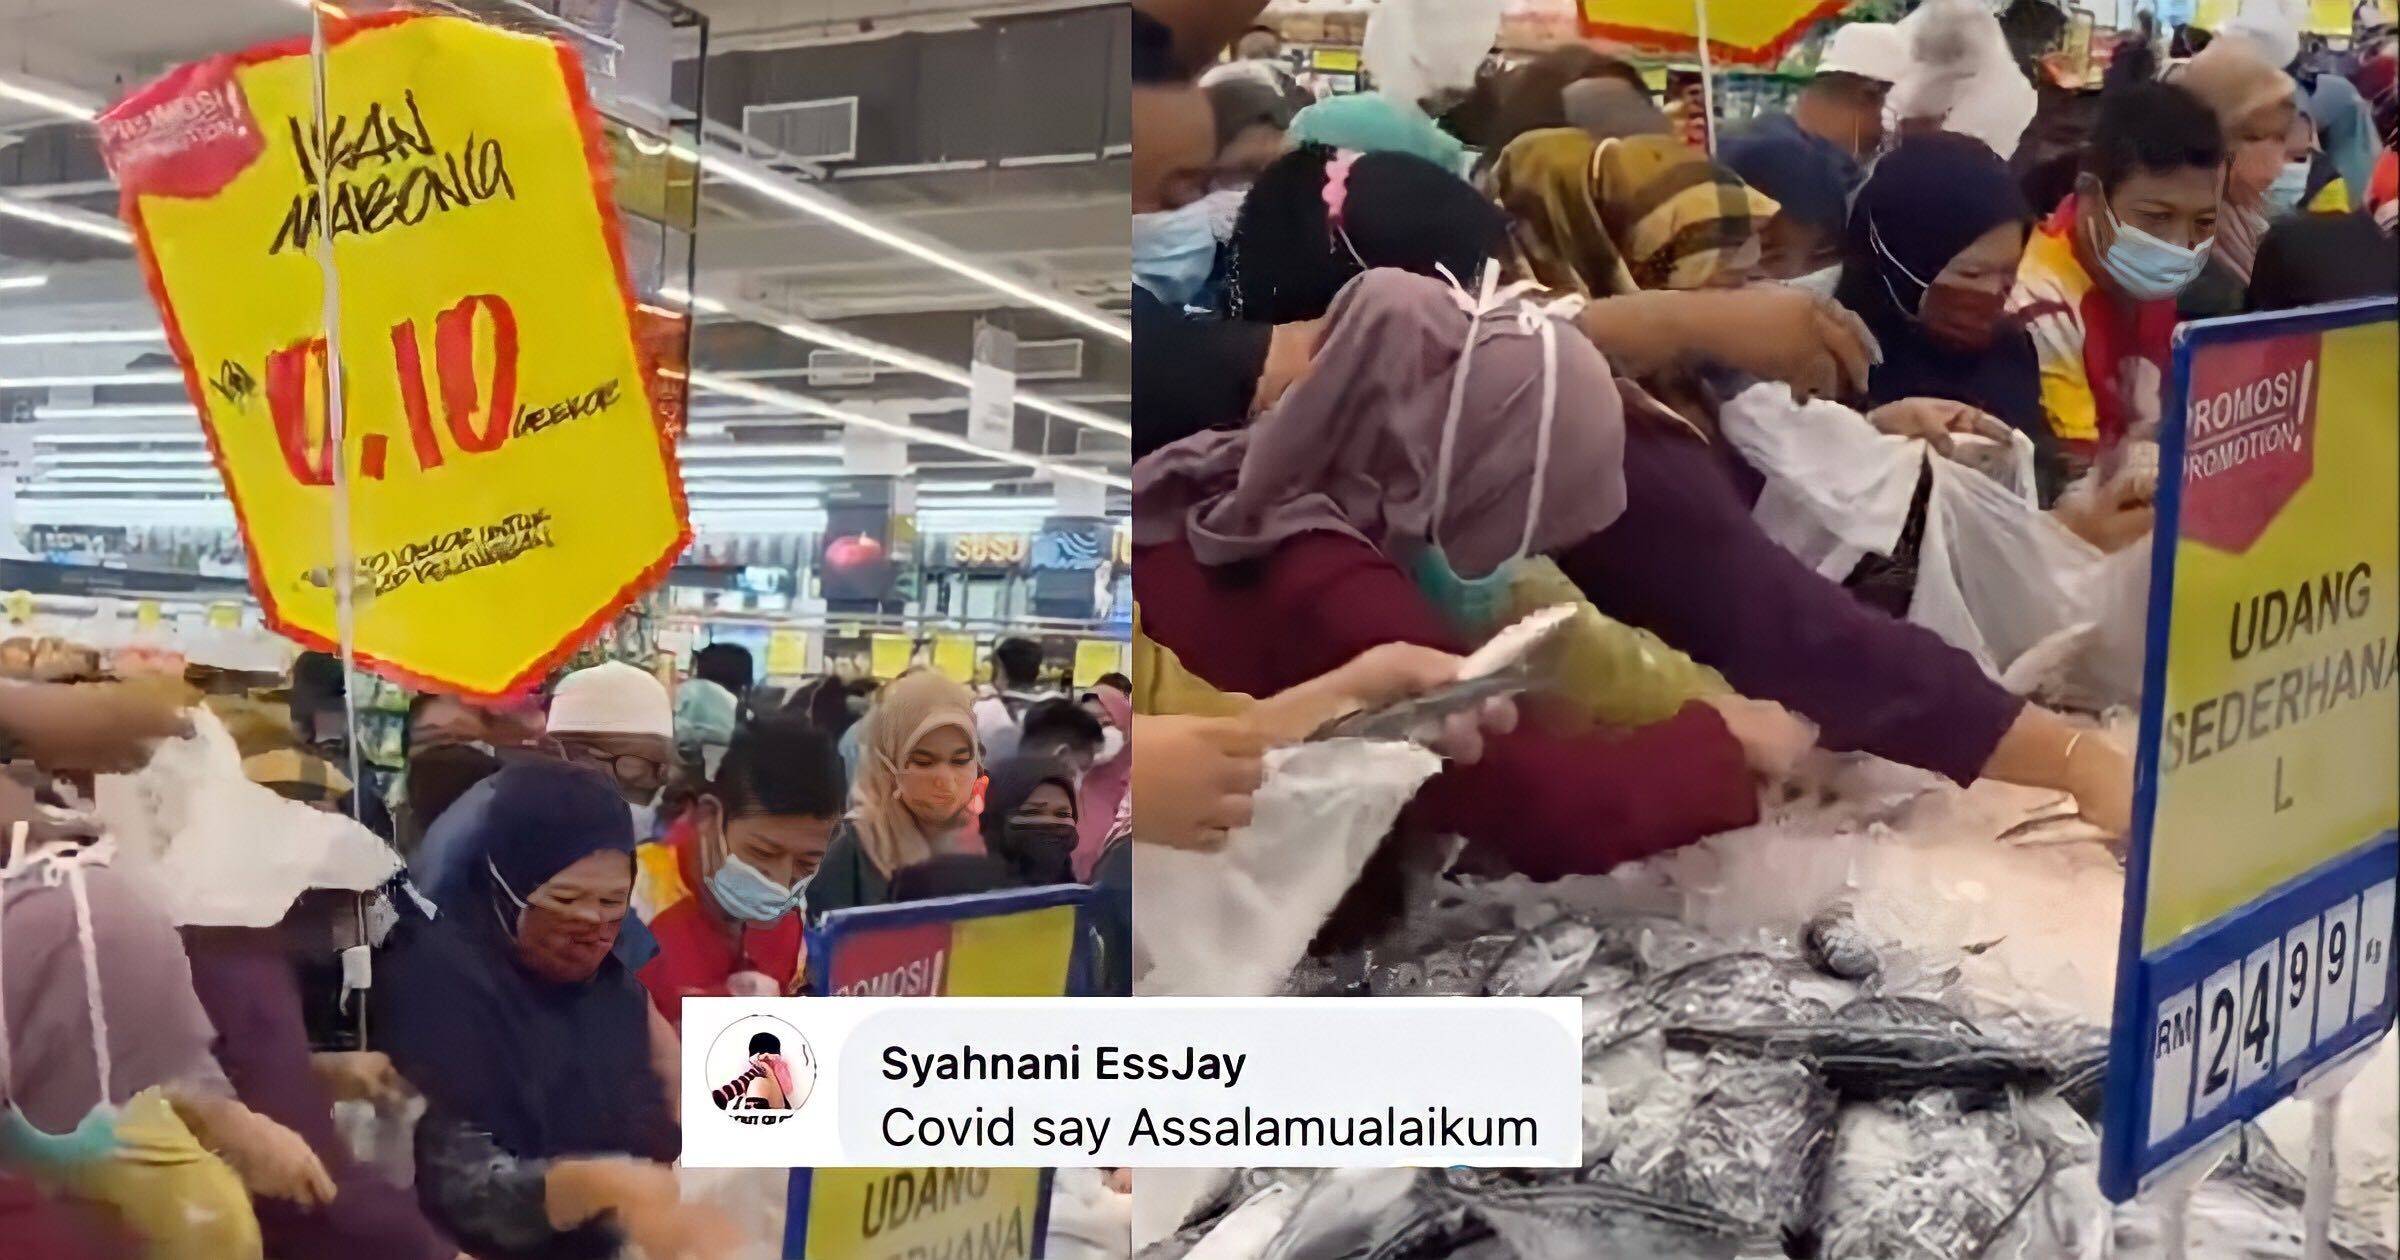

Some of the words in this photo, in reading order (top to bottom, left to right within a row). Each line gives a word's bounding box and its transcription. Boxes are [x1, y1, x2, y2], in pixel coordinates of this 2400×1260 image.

[265, 294, 518, 485] 0.10
[955, 532, 1026, 563] SUSU
[2229, 562, 2372, 662] UDANG
[2274, 756, 2295, 814] L
[2155, 1006, 2194, 1060] RM
